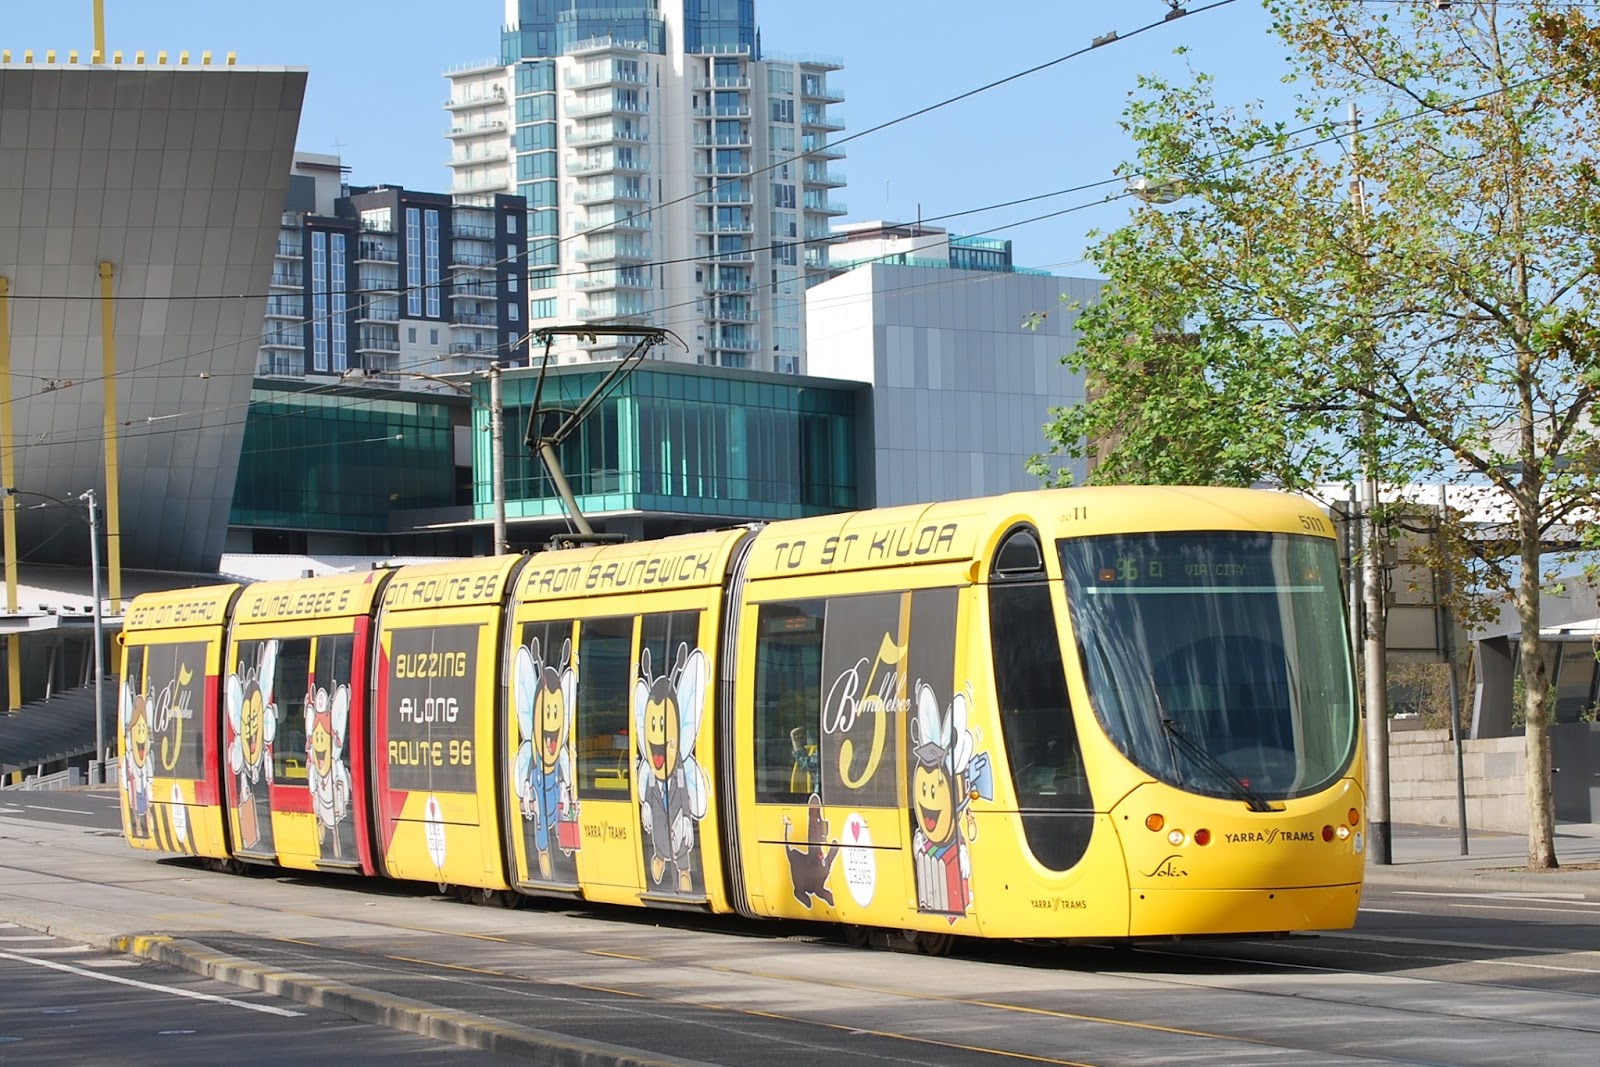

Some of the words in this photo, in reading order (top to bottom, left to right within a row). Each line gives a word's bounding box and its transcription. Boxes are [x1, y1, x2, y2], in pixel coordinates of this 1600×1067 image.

[1298, 515, 1326, 532] 5111
[775, 540, 806, 571] TO
[820, 534, 859, 565] ST
[868, 523, 958, 560] KILDA
[525, 564, 582, 595] FROM
[585, 553, 713, 589] BRUNSWICK
[1116, 558, 1138, 581] 96
[1184, 563, 1208, 576] VIA
[1215, 563, 1246, 576] CITY
[385, 582, 409, 606] ON
[412, 577, 471, 604] ROUTE
[472, 574, 499, 599] 96
[131, 606, 155, 626] GET
[156, 604, 173, 624] ON
[174, 601, 216, 622] BOARD
[251, 591, 336, 618] BUMBLEBEE
[396, 652, 467, 678] BUZZING
[399, 697, 459, 724] ALONG
[388, 741, 443, 767] ROUTE
[449, 740, 472, 766] 96
[584, 825, 601, 838] YARRA
[608, 826, 627, 840] TRAMS
[1225, 832, 1264, 843] YARRA
[1280, 831, 1315, 842] TRAMS
[1031, 899, 1052, 909] YARRA
[1061, 900, 1087, 910] TRAMS
